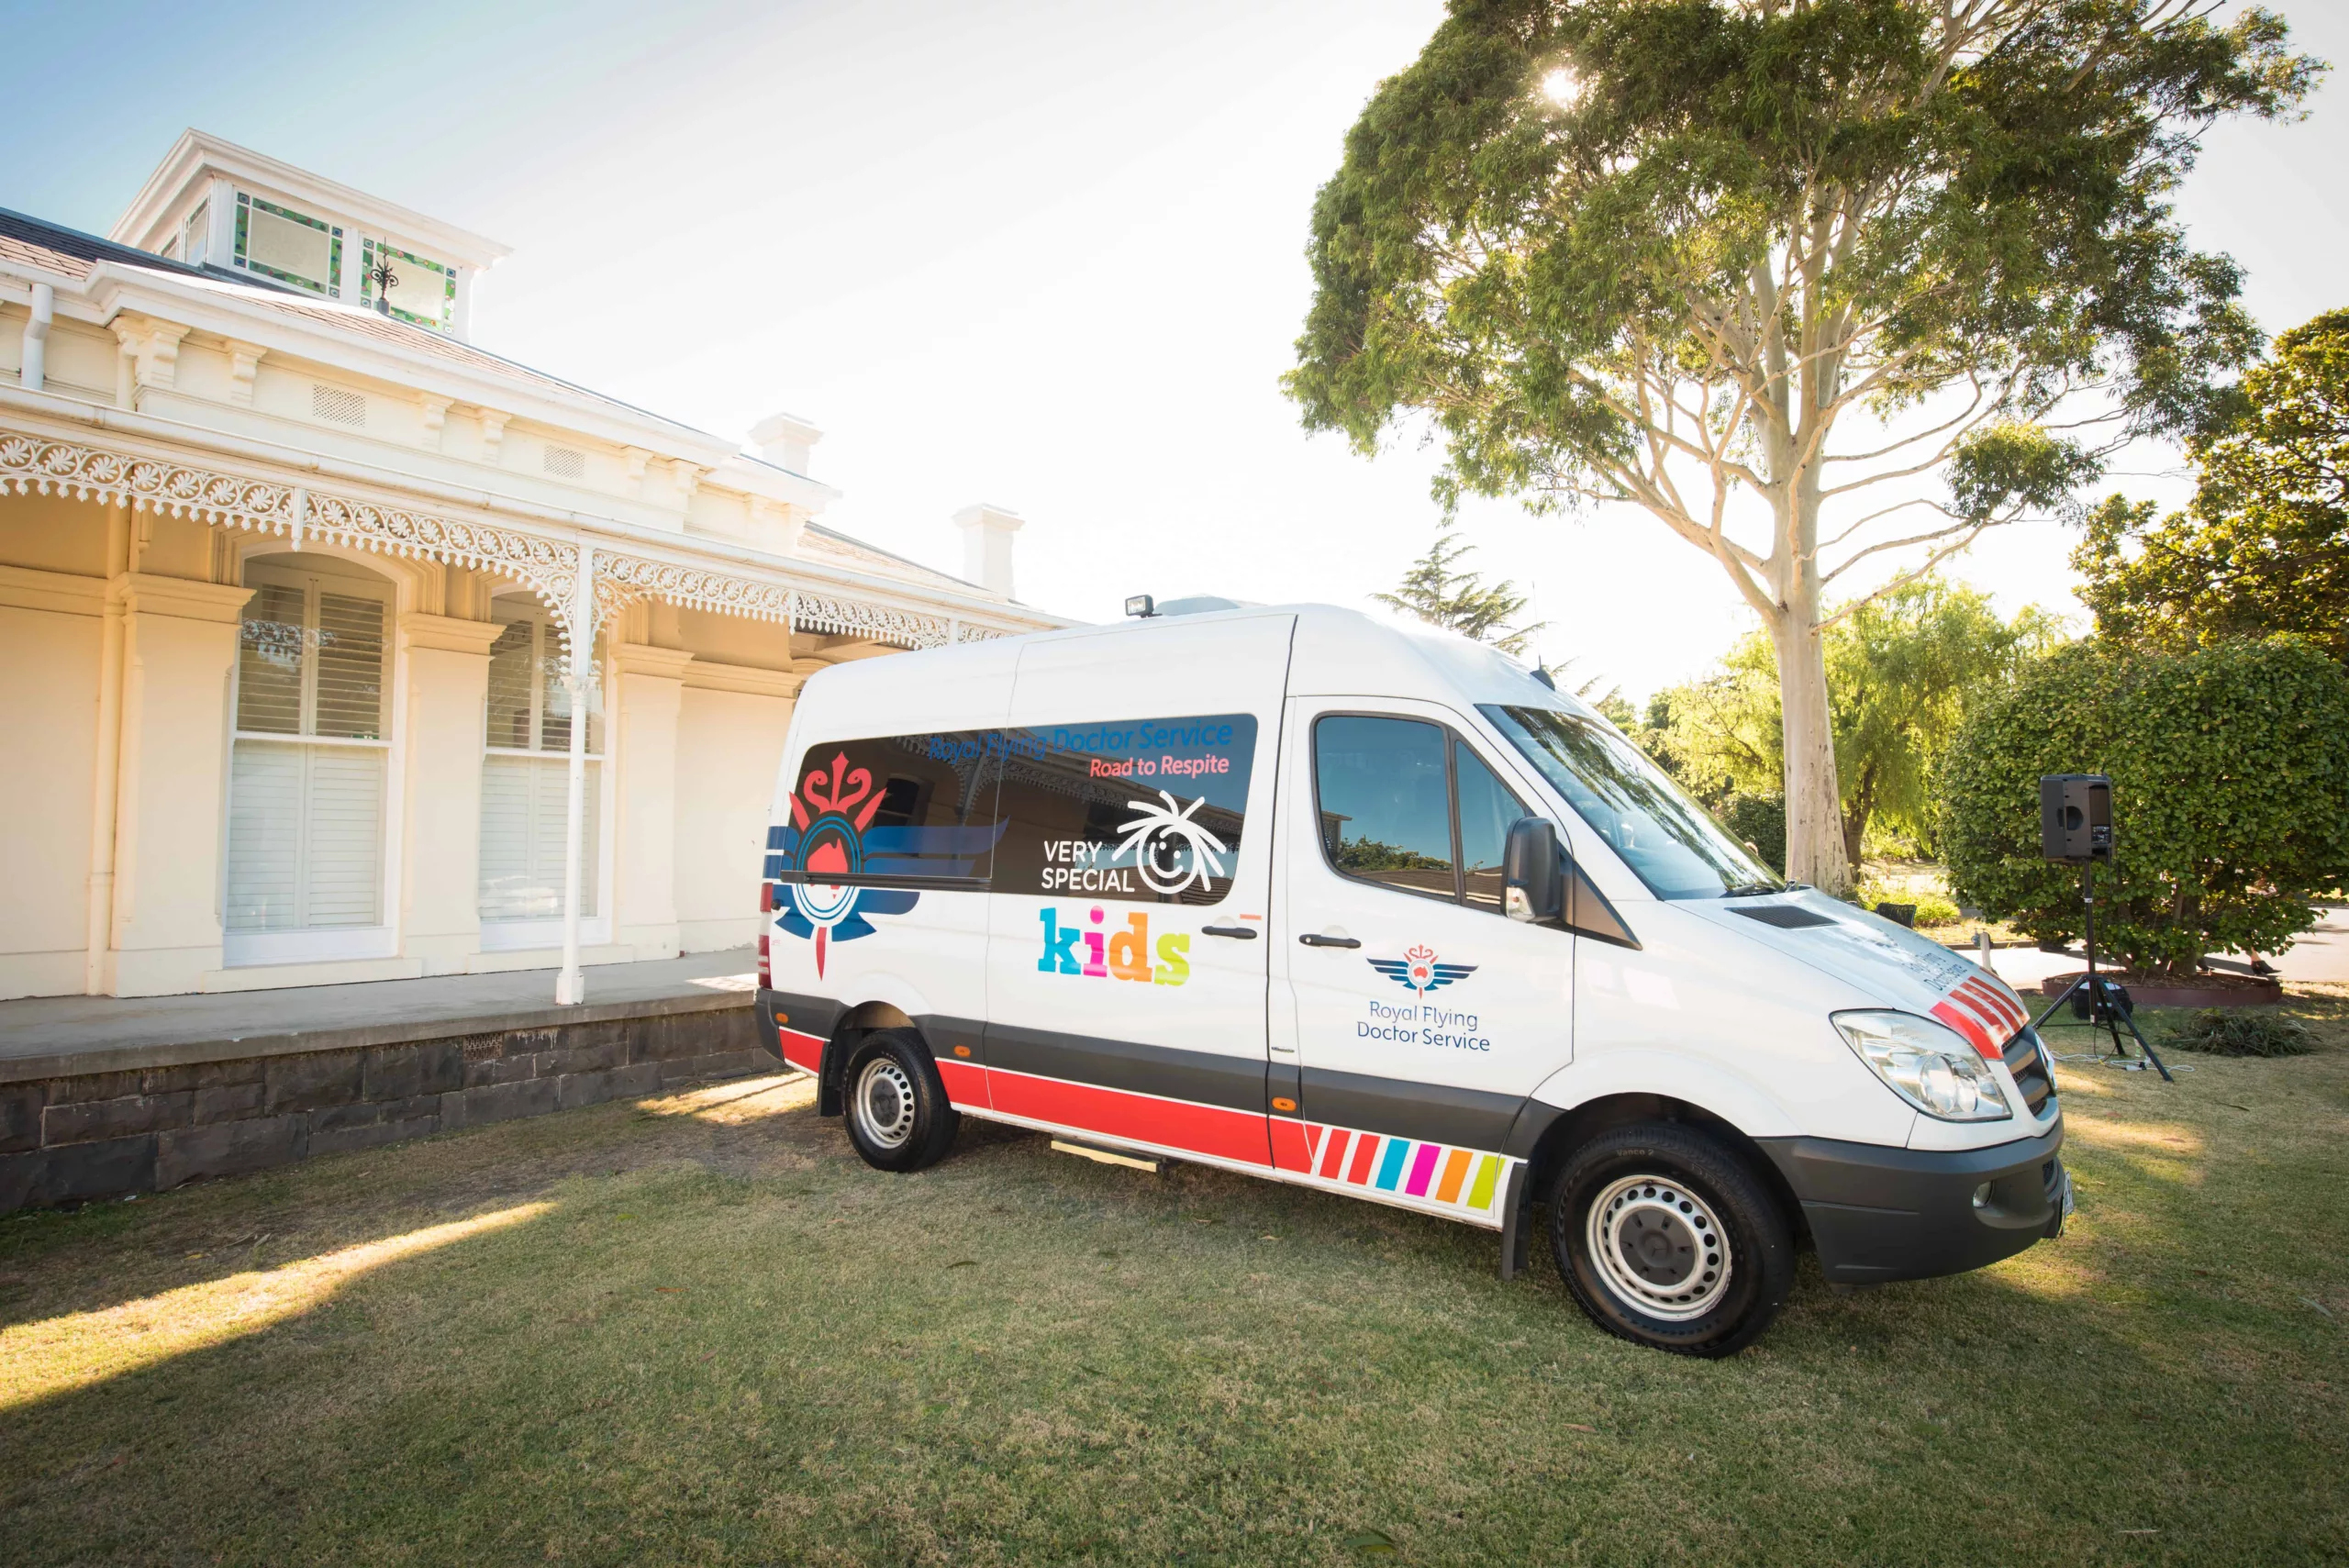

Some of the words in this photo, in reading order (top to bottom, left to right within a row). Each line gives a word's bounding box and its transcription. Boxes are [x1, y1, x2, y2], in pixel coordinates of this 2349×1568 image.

[929, 738, 982, 765] Royal
[986, 732, 1047, 762] Flying
[1053, 727, 1134, 753] Doctor
[1138, 719, 1232, 750] Service
[1090, 757, 1133, 777] Road
[1138, 758, 1156, 776] to
[1161, 753, 1230, 779] Respite
[1043, 840, 1103, 862] VERY
[1041, 867, 1135, 893] SPECIAL
[1038, 905, 1191, 987] kids
[1369, 1001, 1418, 1024] Royal
[1422, 1006, 1478, 1031] Flying
[1357, 1021, 1419, 1043] Doctor
[1422, 1028, 1490, 1051] Service
